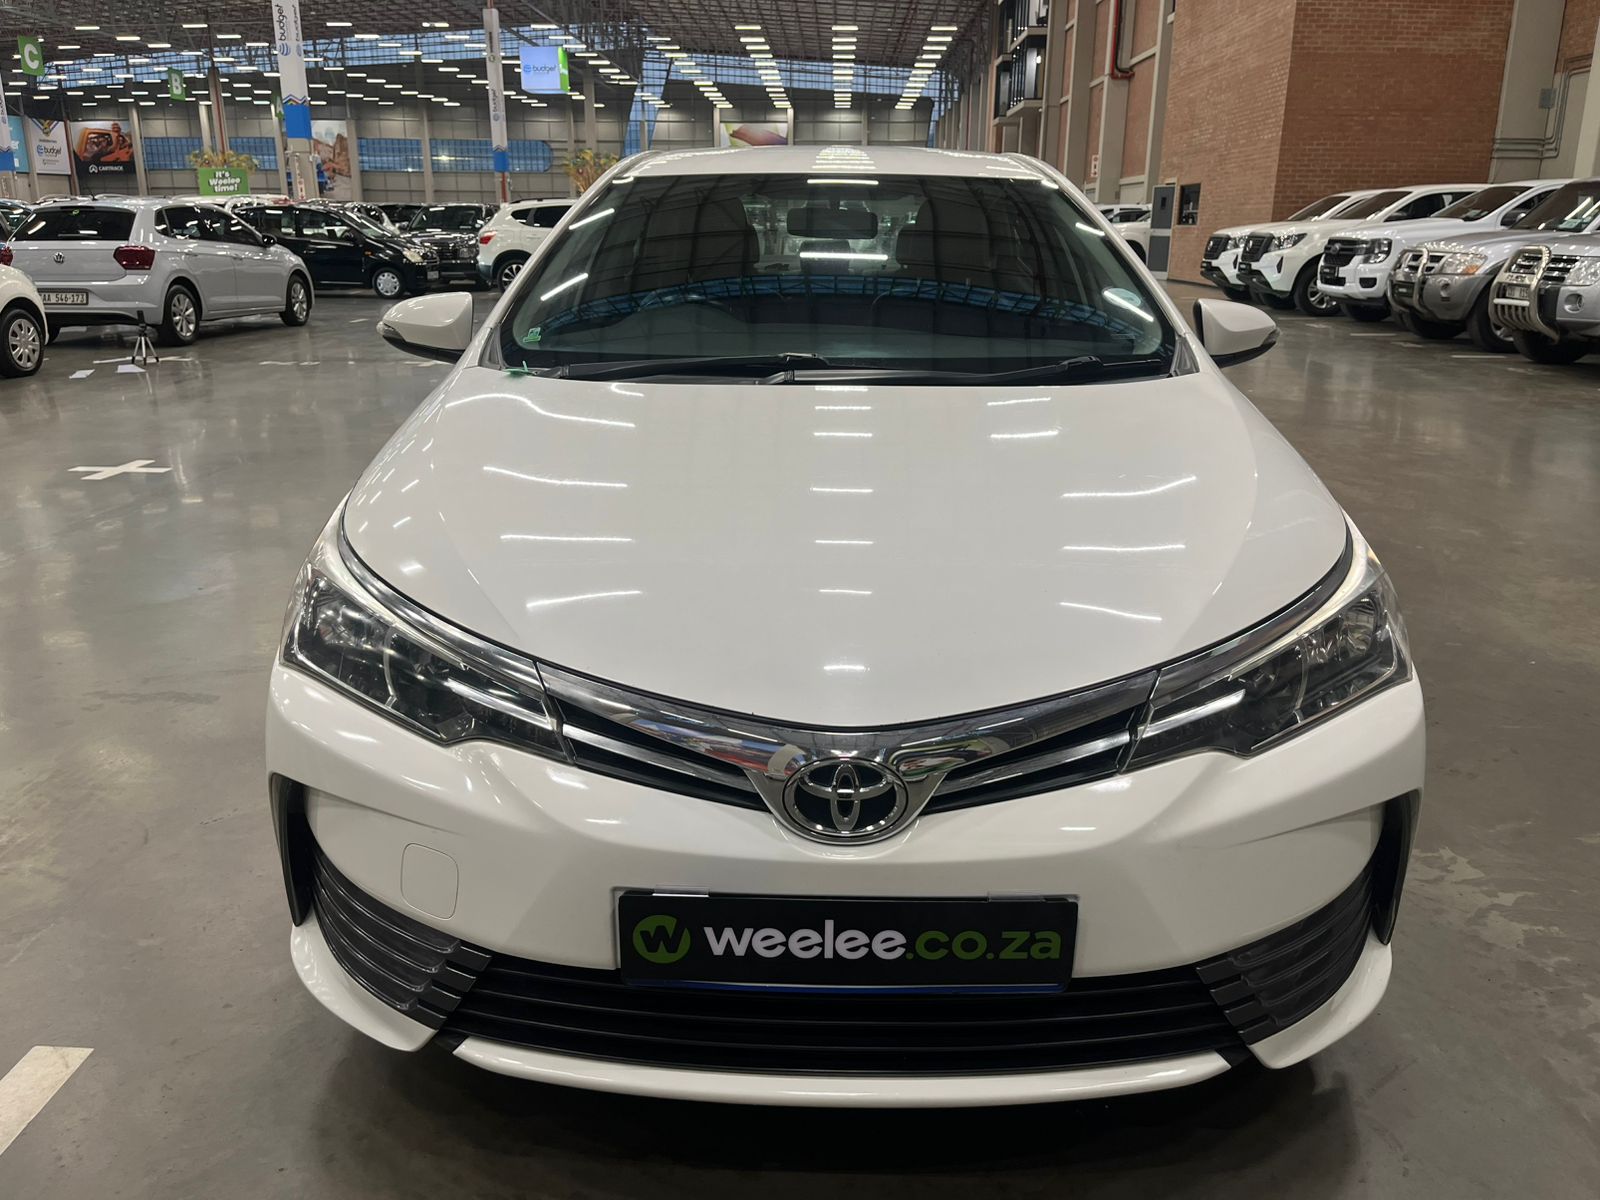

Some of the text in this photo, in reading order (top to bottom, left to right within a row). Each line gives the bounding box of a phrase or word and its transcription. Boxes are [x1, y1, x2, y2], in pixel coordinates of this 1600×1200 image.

[275, 4, 287, 41] budget
[24, 43, 39, 69] C
[532, 64, 557, 74] budget
[171, 73, 182, 95] B
[44, 145, 61, 157] budget
[215, 170, 230, 178] It's
[214, 183, 238, 192] time!
[40, 293, 51, 302] AA
[703, 919, 1062, 960] weelee.co.za
